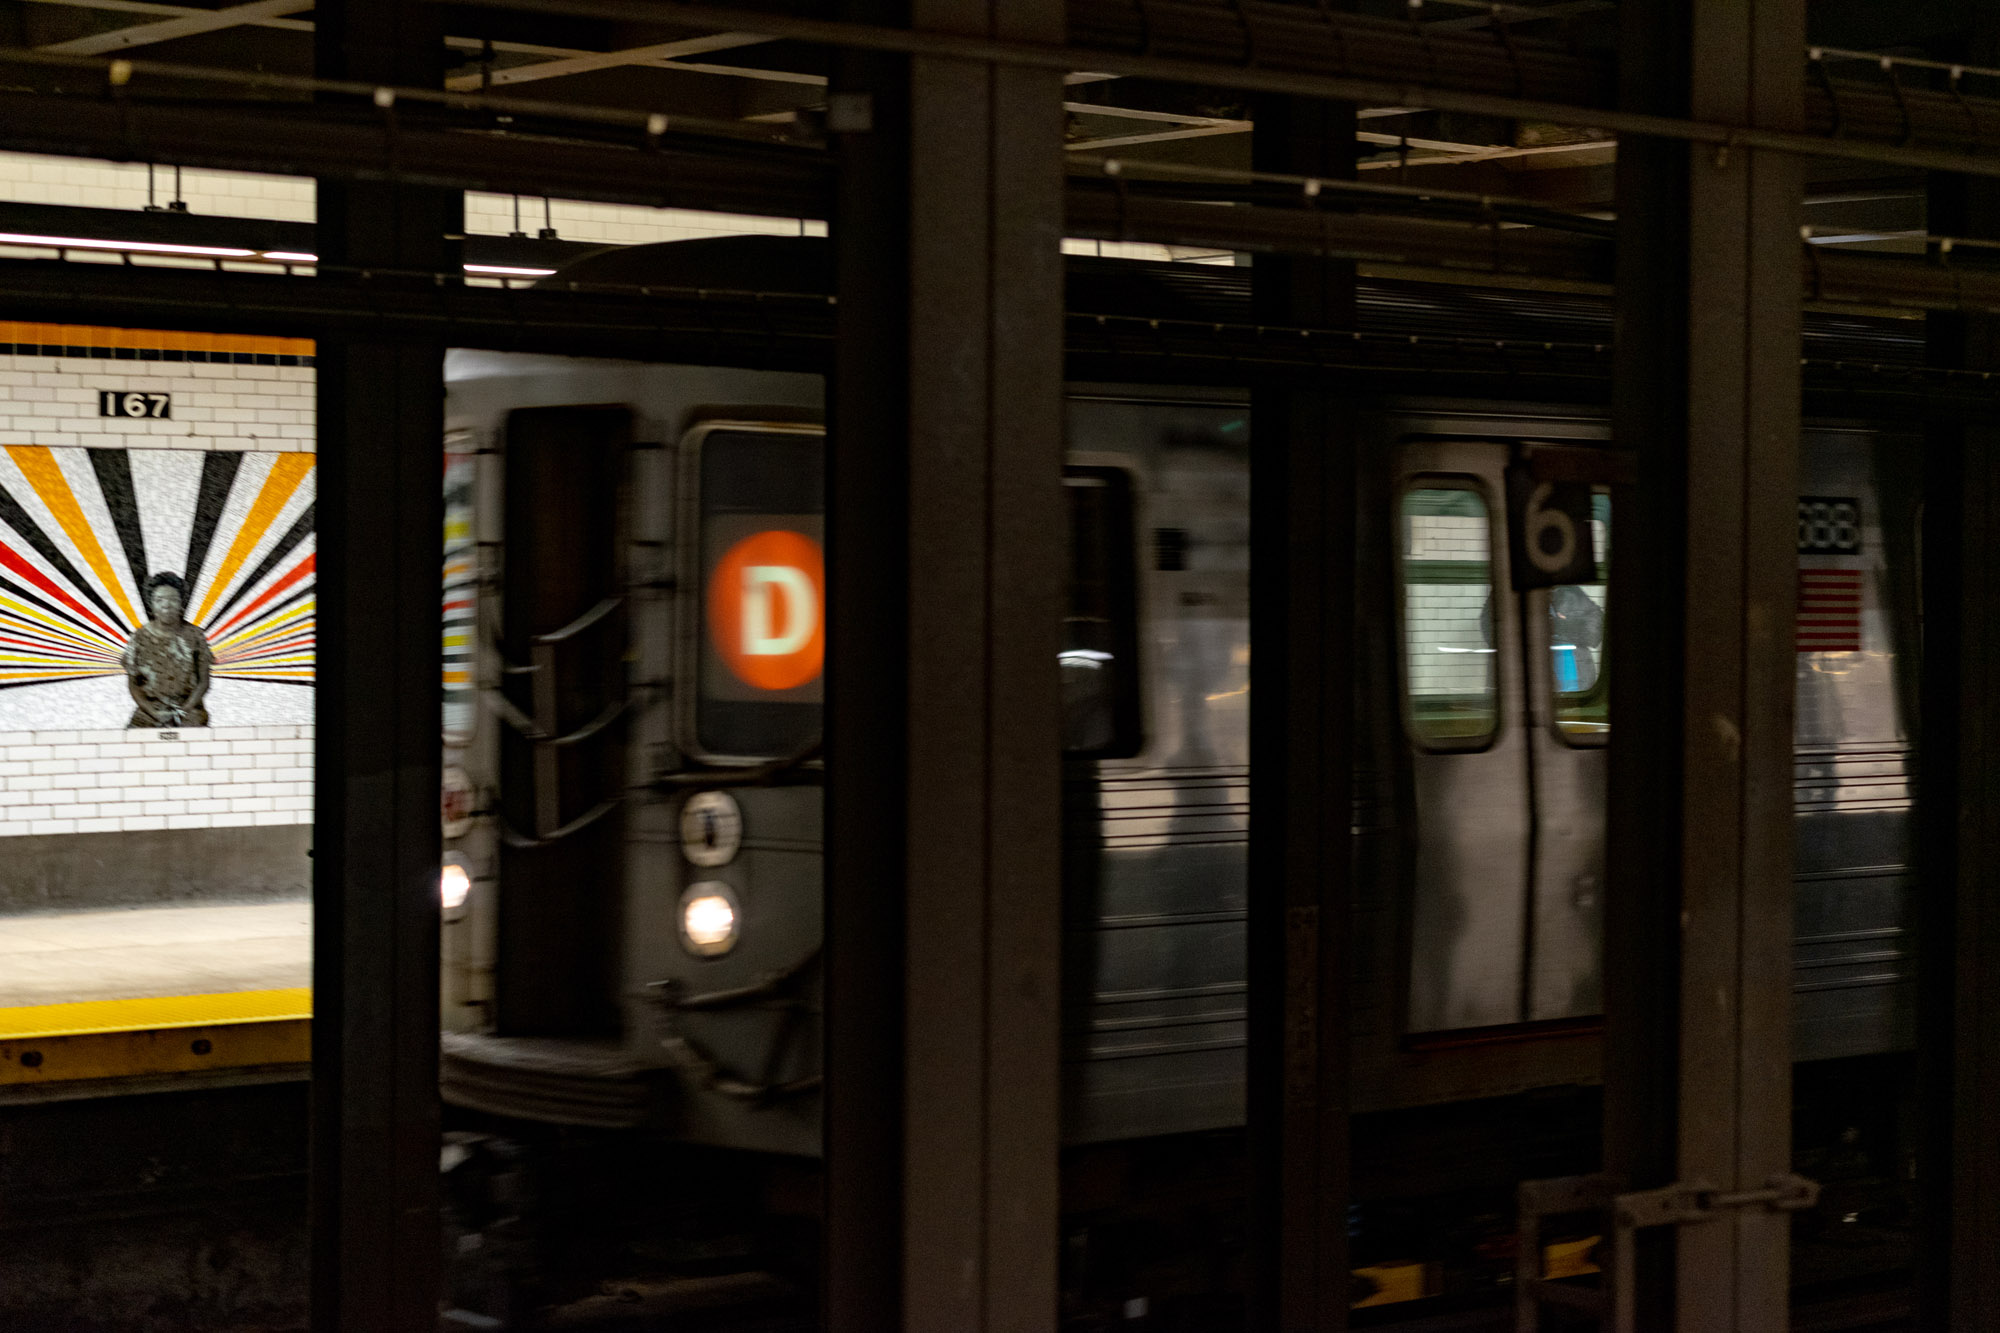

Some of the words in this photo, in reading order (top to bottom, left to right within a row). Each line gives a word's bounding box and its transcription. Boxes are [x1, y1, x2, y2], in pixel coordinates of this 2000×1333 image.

[105, 392, 169, 418] 167
[1524, 480, 1576, 573] 6
[740, 565, 820, 656] D
